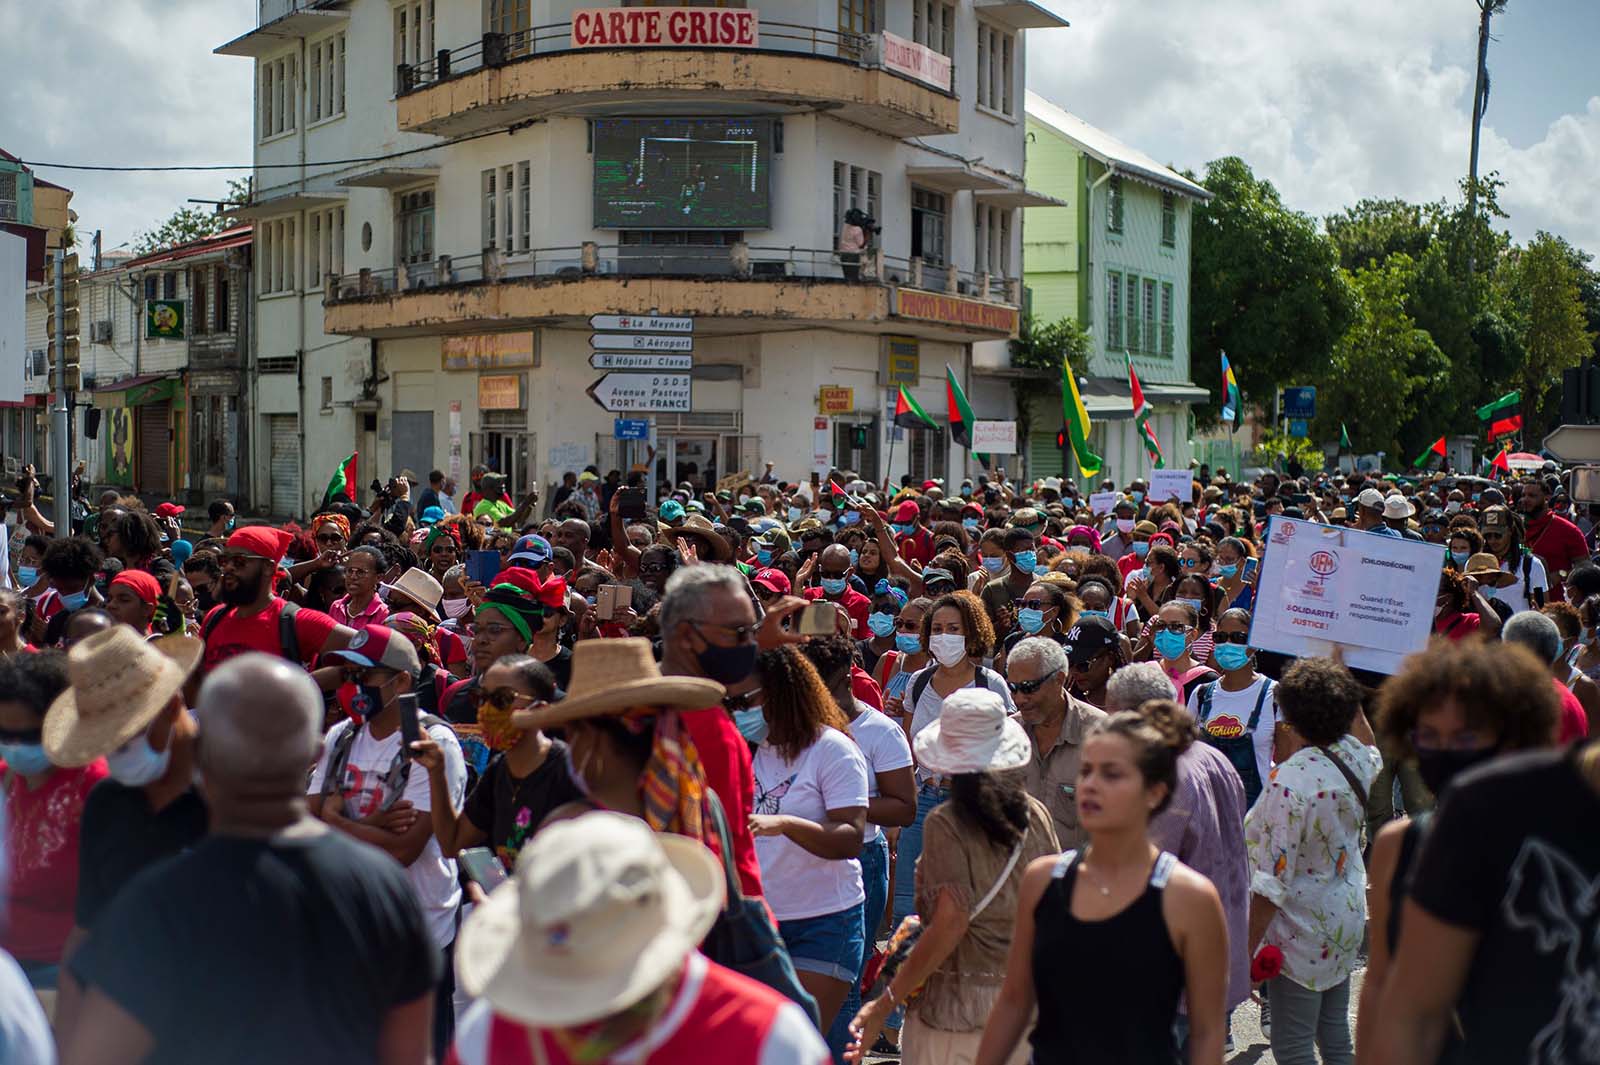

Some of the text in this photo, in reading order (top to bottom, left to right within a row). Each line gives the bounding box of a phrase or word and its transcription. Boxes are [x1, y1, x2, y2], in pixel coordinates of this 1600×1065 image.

[574, 11, 753, 45] CARTE GRISE
[632, 319, 691, 329] La Meynard
[647, 337, 690, 349] Aéroport
[615, 357, 652, 367] Hôpital
[657, 357, 690, 367] Clarac
[611, 388, 688, 397] Avenue Pasteur
[610, 399, 635, 407] FORT
[649, 400, 688, 408] FRANCE
[1359, 594, 1383, 604] Quand
[1348, 611, 1403, 626] responsabilités
[1398, 610, 1411, 618] ses
